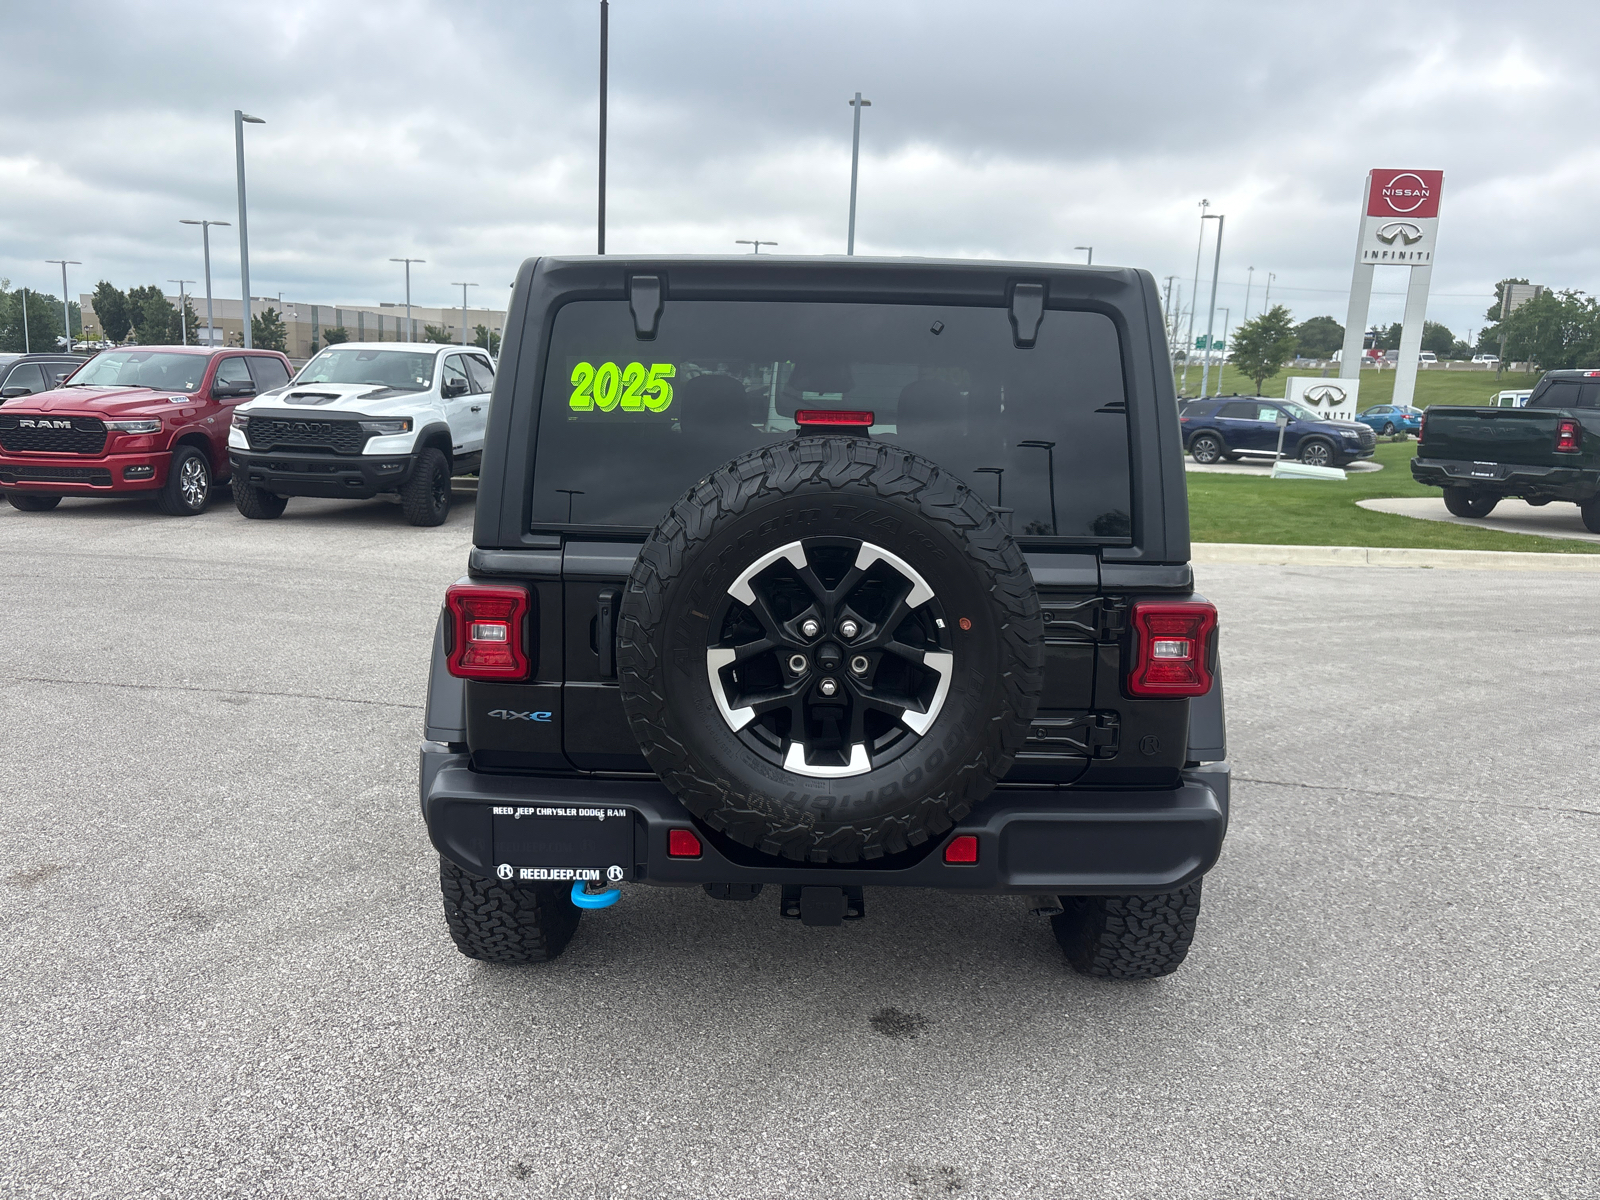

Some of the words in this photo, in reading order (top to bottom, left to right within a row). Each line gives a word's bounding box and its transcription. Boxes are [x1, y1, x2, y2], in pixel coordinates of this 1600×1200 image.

[1382, 188, 1430, 197] NISSAN
[1363, 250, 1430, 260] INFINITI
[569, 361, 676, 413] 2025
[19, 419, 72, 429] RAM
[272, 421, 332, 433] RAM
[832, 503, 903, 534] T/A
[783, 666, 986, 811] BFGoodrich
[493, 806, 513, 815] REED
[515, 807, 534, 815] JEEP
[536, 807, 577, 816] CHRYSLER
[579, 808, 605, 817] DODGE
[607, 809, 626, 817] RAM
[520, 868, 600, 880] REEDJEEP.COM
